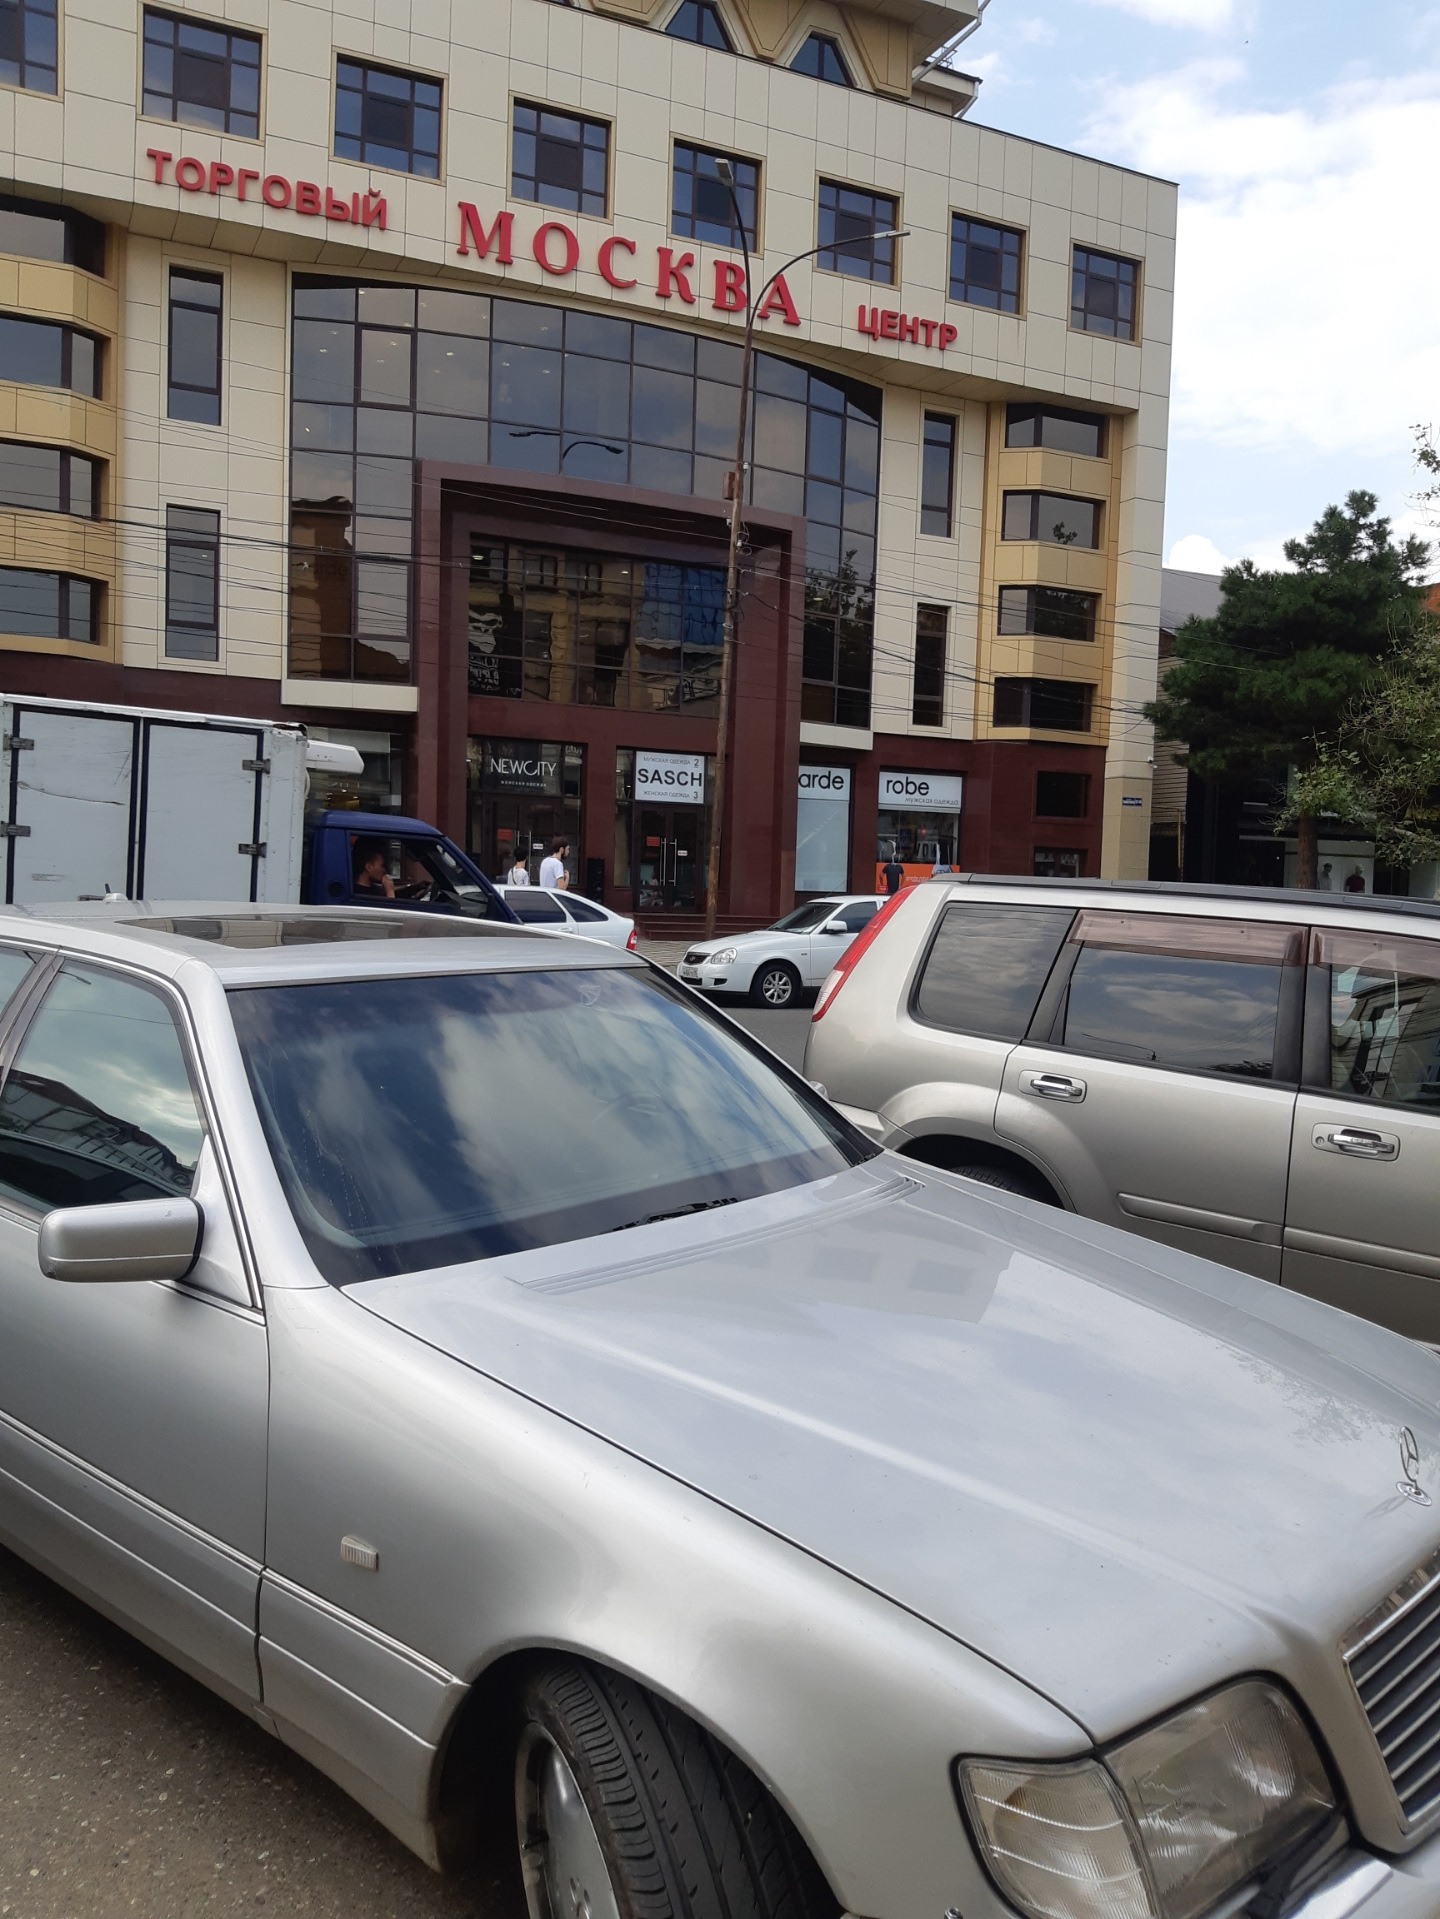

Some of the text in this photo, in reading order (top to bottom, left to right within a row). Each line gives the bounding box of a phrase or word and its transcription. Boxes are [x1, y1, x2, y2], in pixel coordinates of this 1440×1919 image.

[147, 148, 387, 231] ТОРГОВЫЙ
[456, 201, 802, 326] МОСКВА
[858, 304, 958, 350] ЦЕНТР
[490, 758, 557, 776] NEWCITY
[694, 758, 699, 767] 2
[637, 768, 702, 787] SASCH
[886, 777, 930, 796] robe
[693, 791, 698, 799] 3
